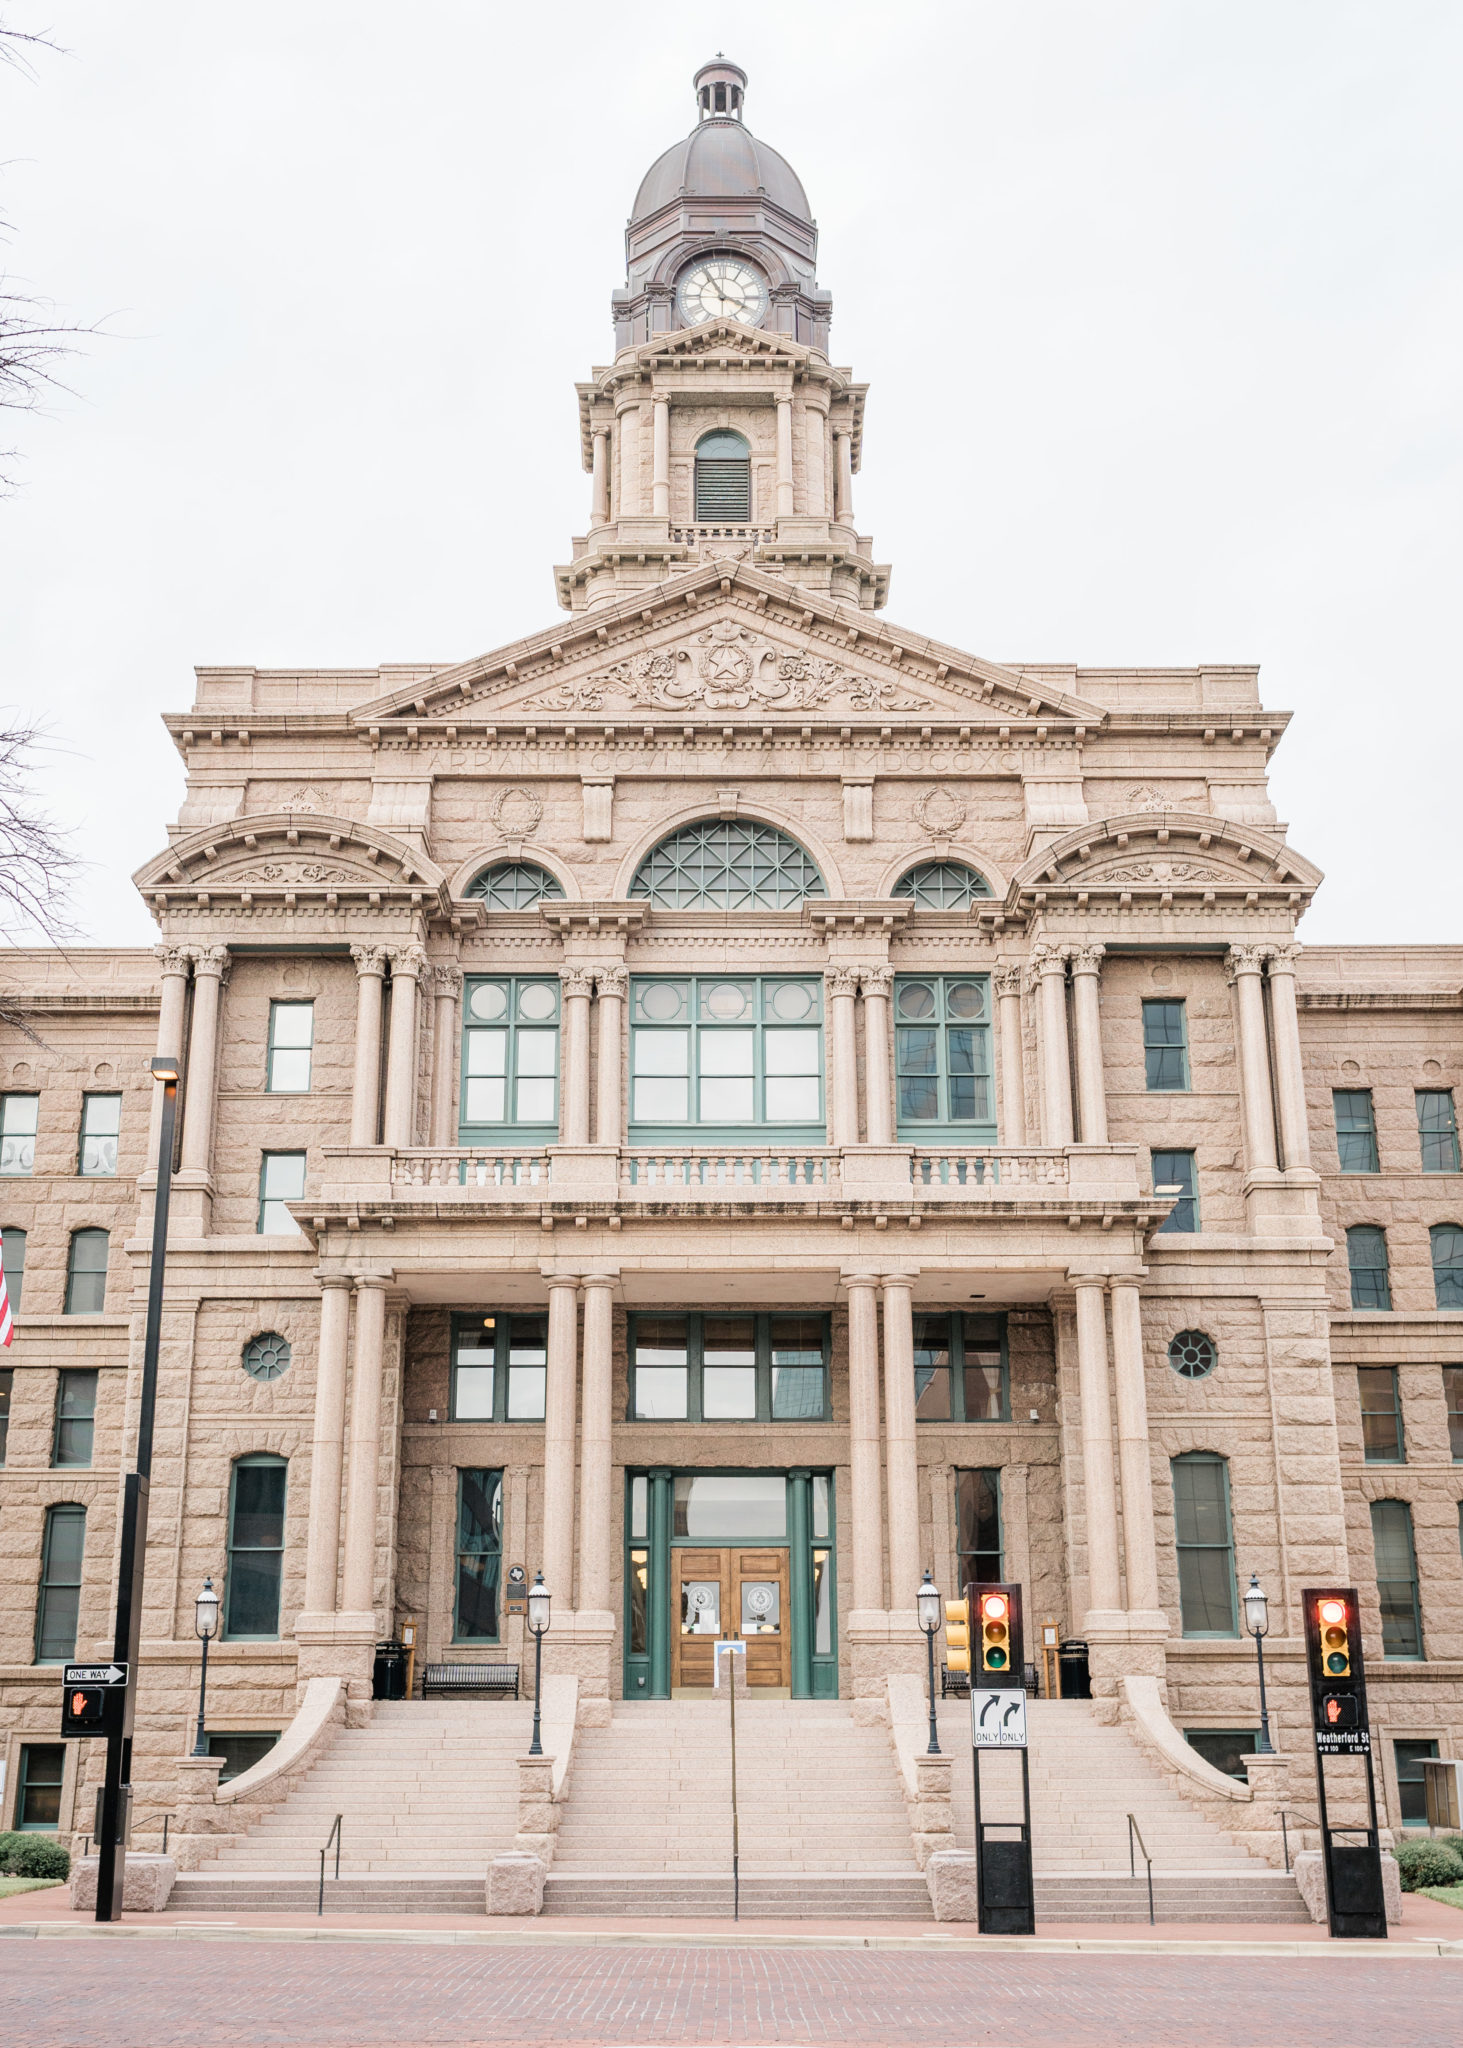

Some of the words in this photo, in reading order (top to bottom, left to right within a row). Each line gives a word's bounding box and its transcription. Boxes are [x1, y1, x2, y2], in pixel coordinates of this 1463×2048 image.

[403, 752, 564, 772] TARRANT
[69, 1670, 87, 1679] ONE
[90, 1670, 108, 1679] WAY
[976, 1732, 998, 1742] ONLY
[1002, 1732, 1024, 1742] ONLY
[1316, 1732, 1359, 1743] Weatherford
[1361, 1732, 1369, 1743] St
